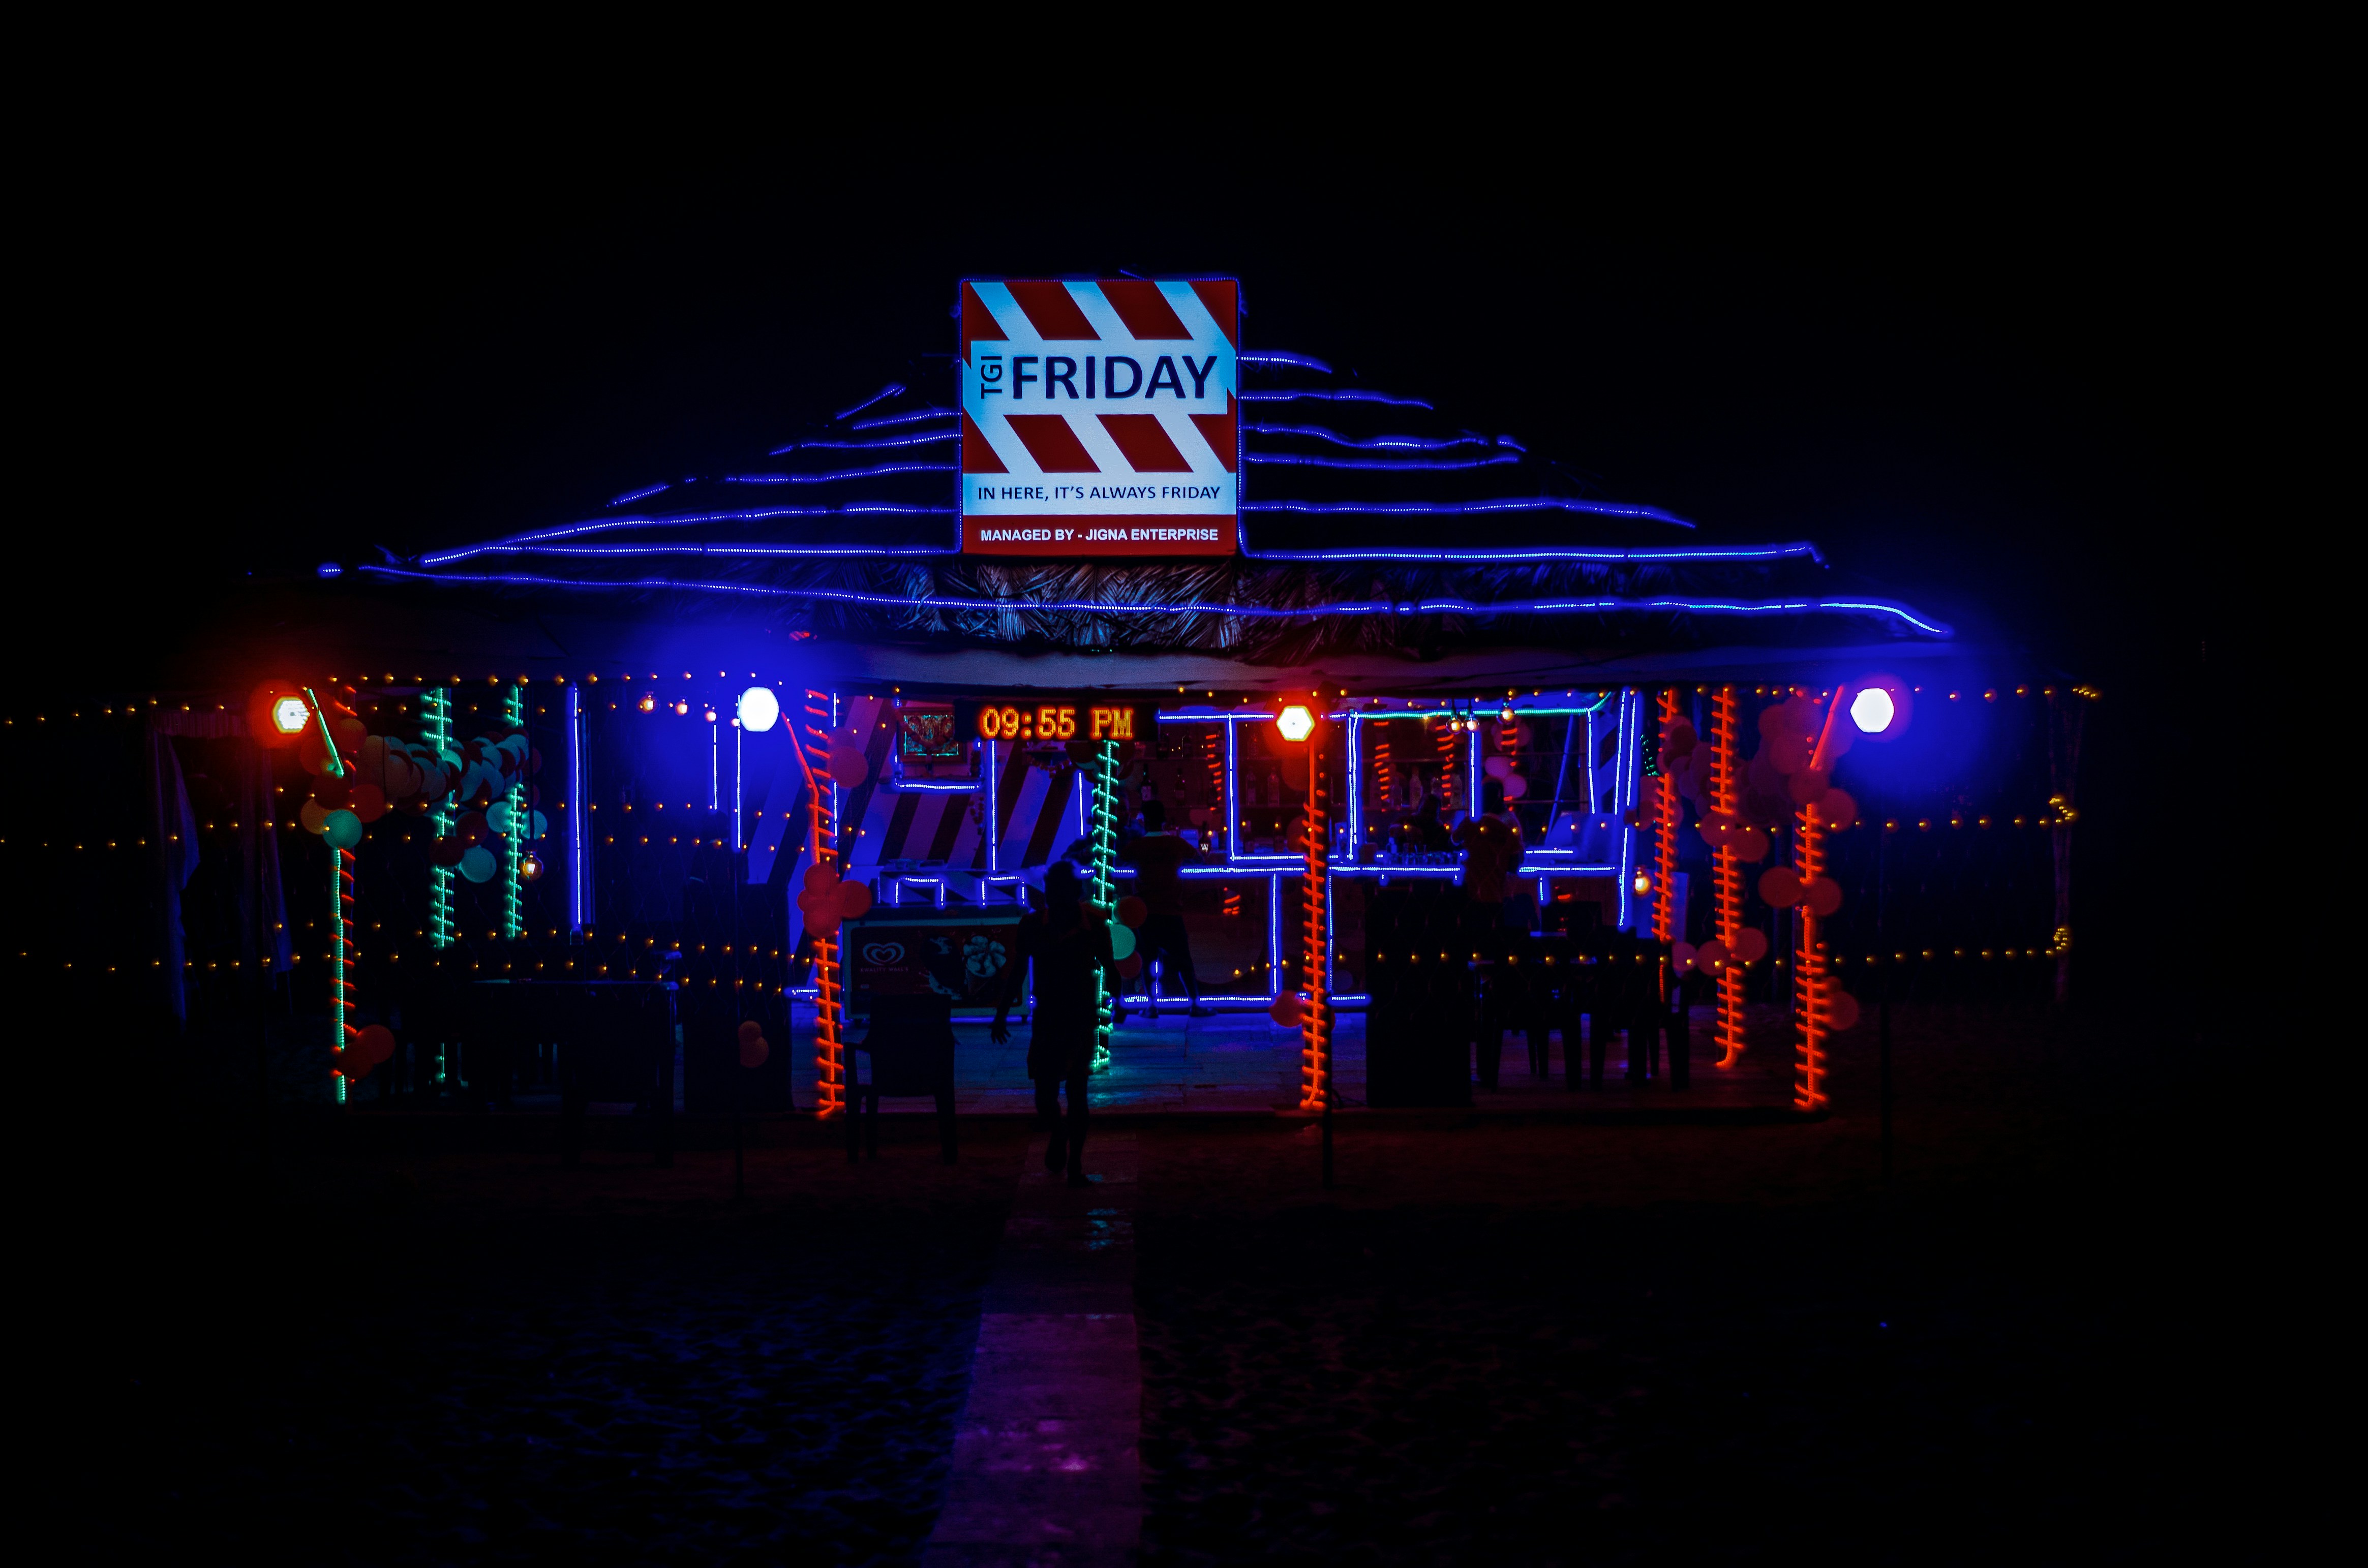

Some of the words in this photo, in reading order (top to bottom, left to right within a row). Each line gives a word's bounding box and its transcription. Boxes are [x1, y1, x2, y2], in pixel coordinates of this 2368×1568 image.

[980, 355, 1003, 399] TGI
[1013, 355, 1218, 399] FRIDAY
[978, 486, 995, 499] IN
[1001, 486, 1048, 501] HERE,
[1055, 486, 1084, 499] IT'S
[1089, 486, 1156, 499] ALWAYS
[1162, 486, 1220, 499] FRIDAY
[980, 529, 1051, 541] MANAGED
[1055, 529, 1074, 541] BY
[1085, 529, 1128, 541] JIGNA
[1131, 529, 1218, 541] ENTERPRISE
[983, 709, 1075, 737] 09:55
[1092, 709, 1133, 737] PM
